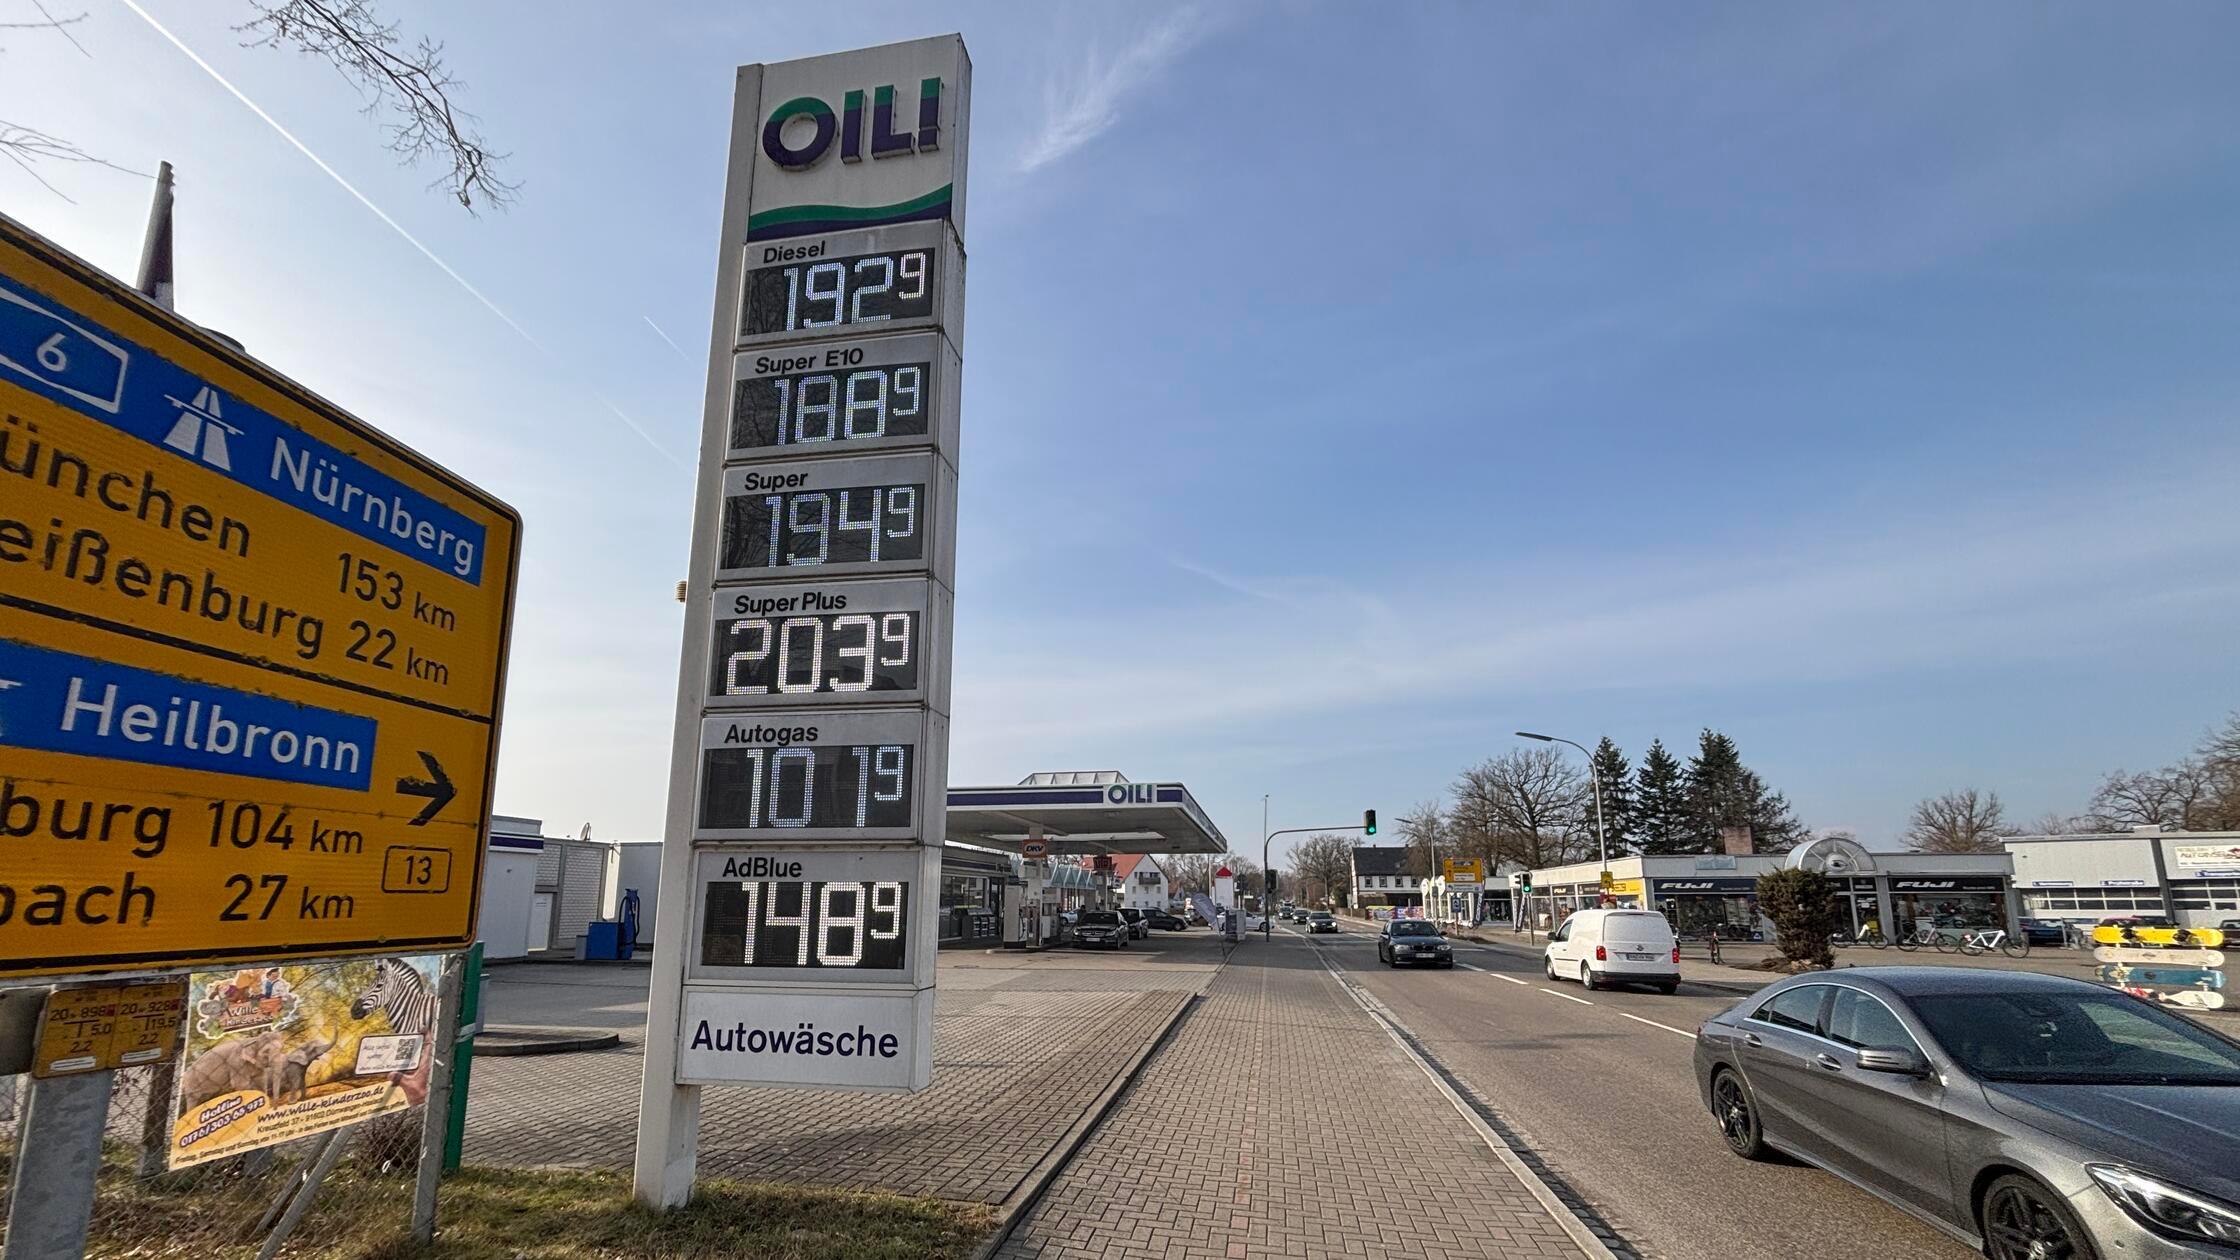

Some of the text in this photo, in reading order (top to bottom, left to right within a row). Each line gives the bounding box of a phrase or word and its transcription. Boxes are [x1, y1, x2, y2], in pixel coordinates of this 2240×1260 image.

[762, 76, 944, 171] OIL!
[763, 240, 826, 264] Diesel
[36, 333, 68, 371] 6
[755, 348, 864, 375] Super E10
[745, 472, 808, 493] Super
[270, 437, 474, 576] Nürnberg
[338, 552, 402, 610] 153
[414, 592, 456, 632] km
[346, 621, 397, 670] 22
[407, 654, 449, 686] km
[60, 677, 360, 773] Heilbronn
[724, 724, 819, 747] Autogas
[1108, 784, 1153, 804] OIL!
[208, 800, 295, 850] 104
[309, 820, 363, 854] km
[404, 855, 432, 886] 13
[722, 857, 803, 878] AdBlue
[220, 874, 289, 922] 27
[299, 887, 355, 919] km
[690, 1020, 899, 1058] Autowäsche
